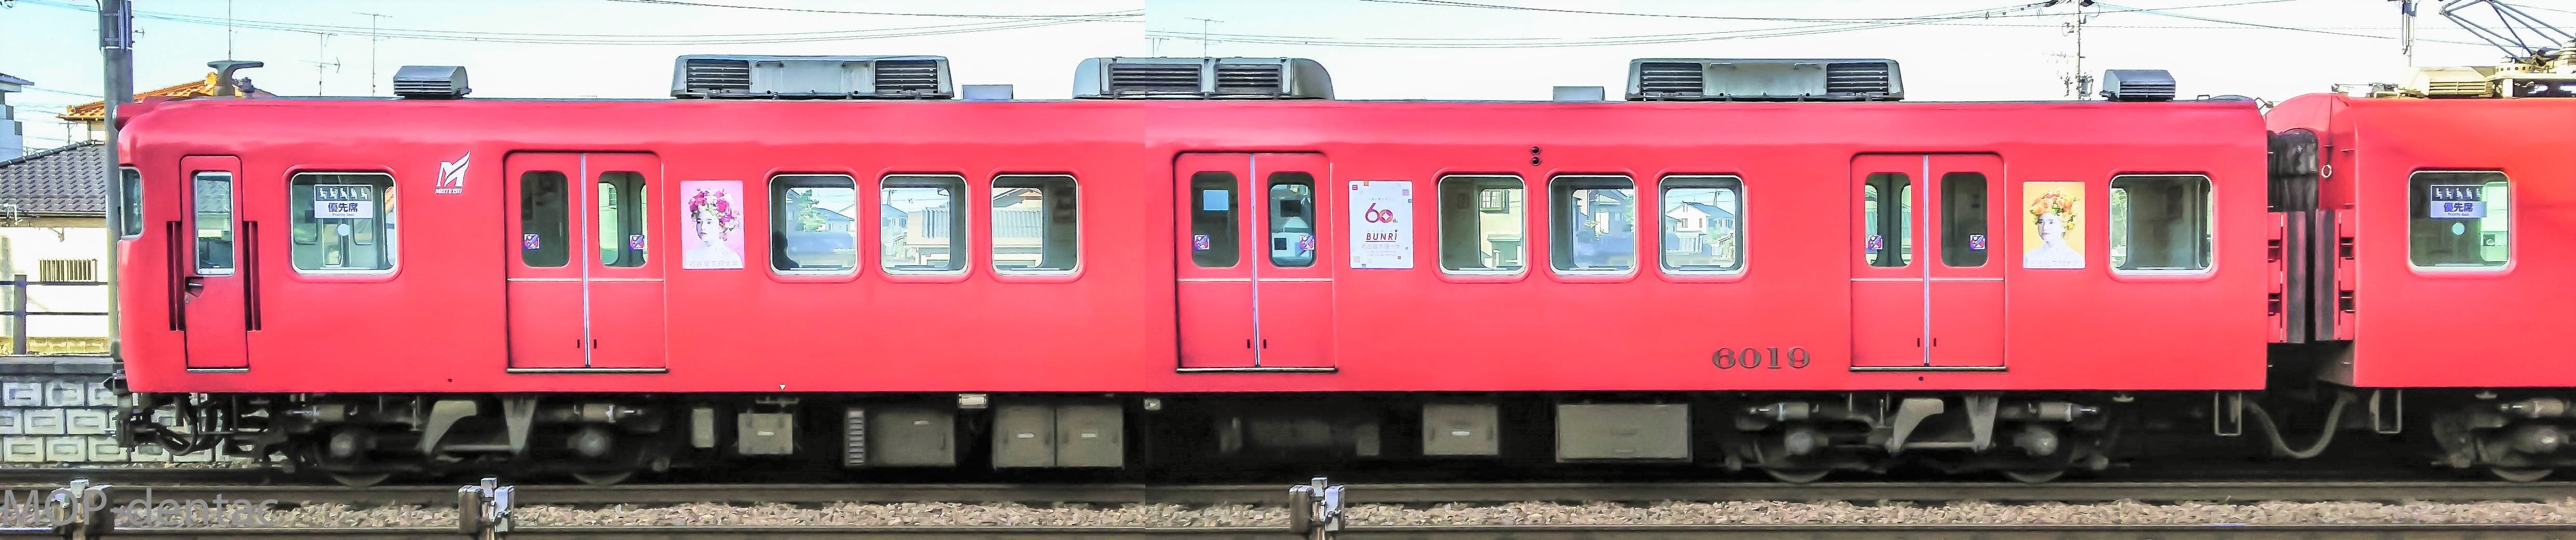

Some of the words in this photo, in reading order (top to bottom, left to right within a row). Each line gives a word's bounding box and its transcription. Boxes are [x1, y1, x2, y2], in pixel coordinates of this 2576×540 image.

[328, 203, 358, 212] 優先席
[1712, 347, 1810, 369] 6019
